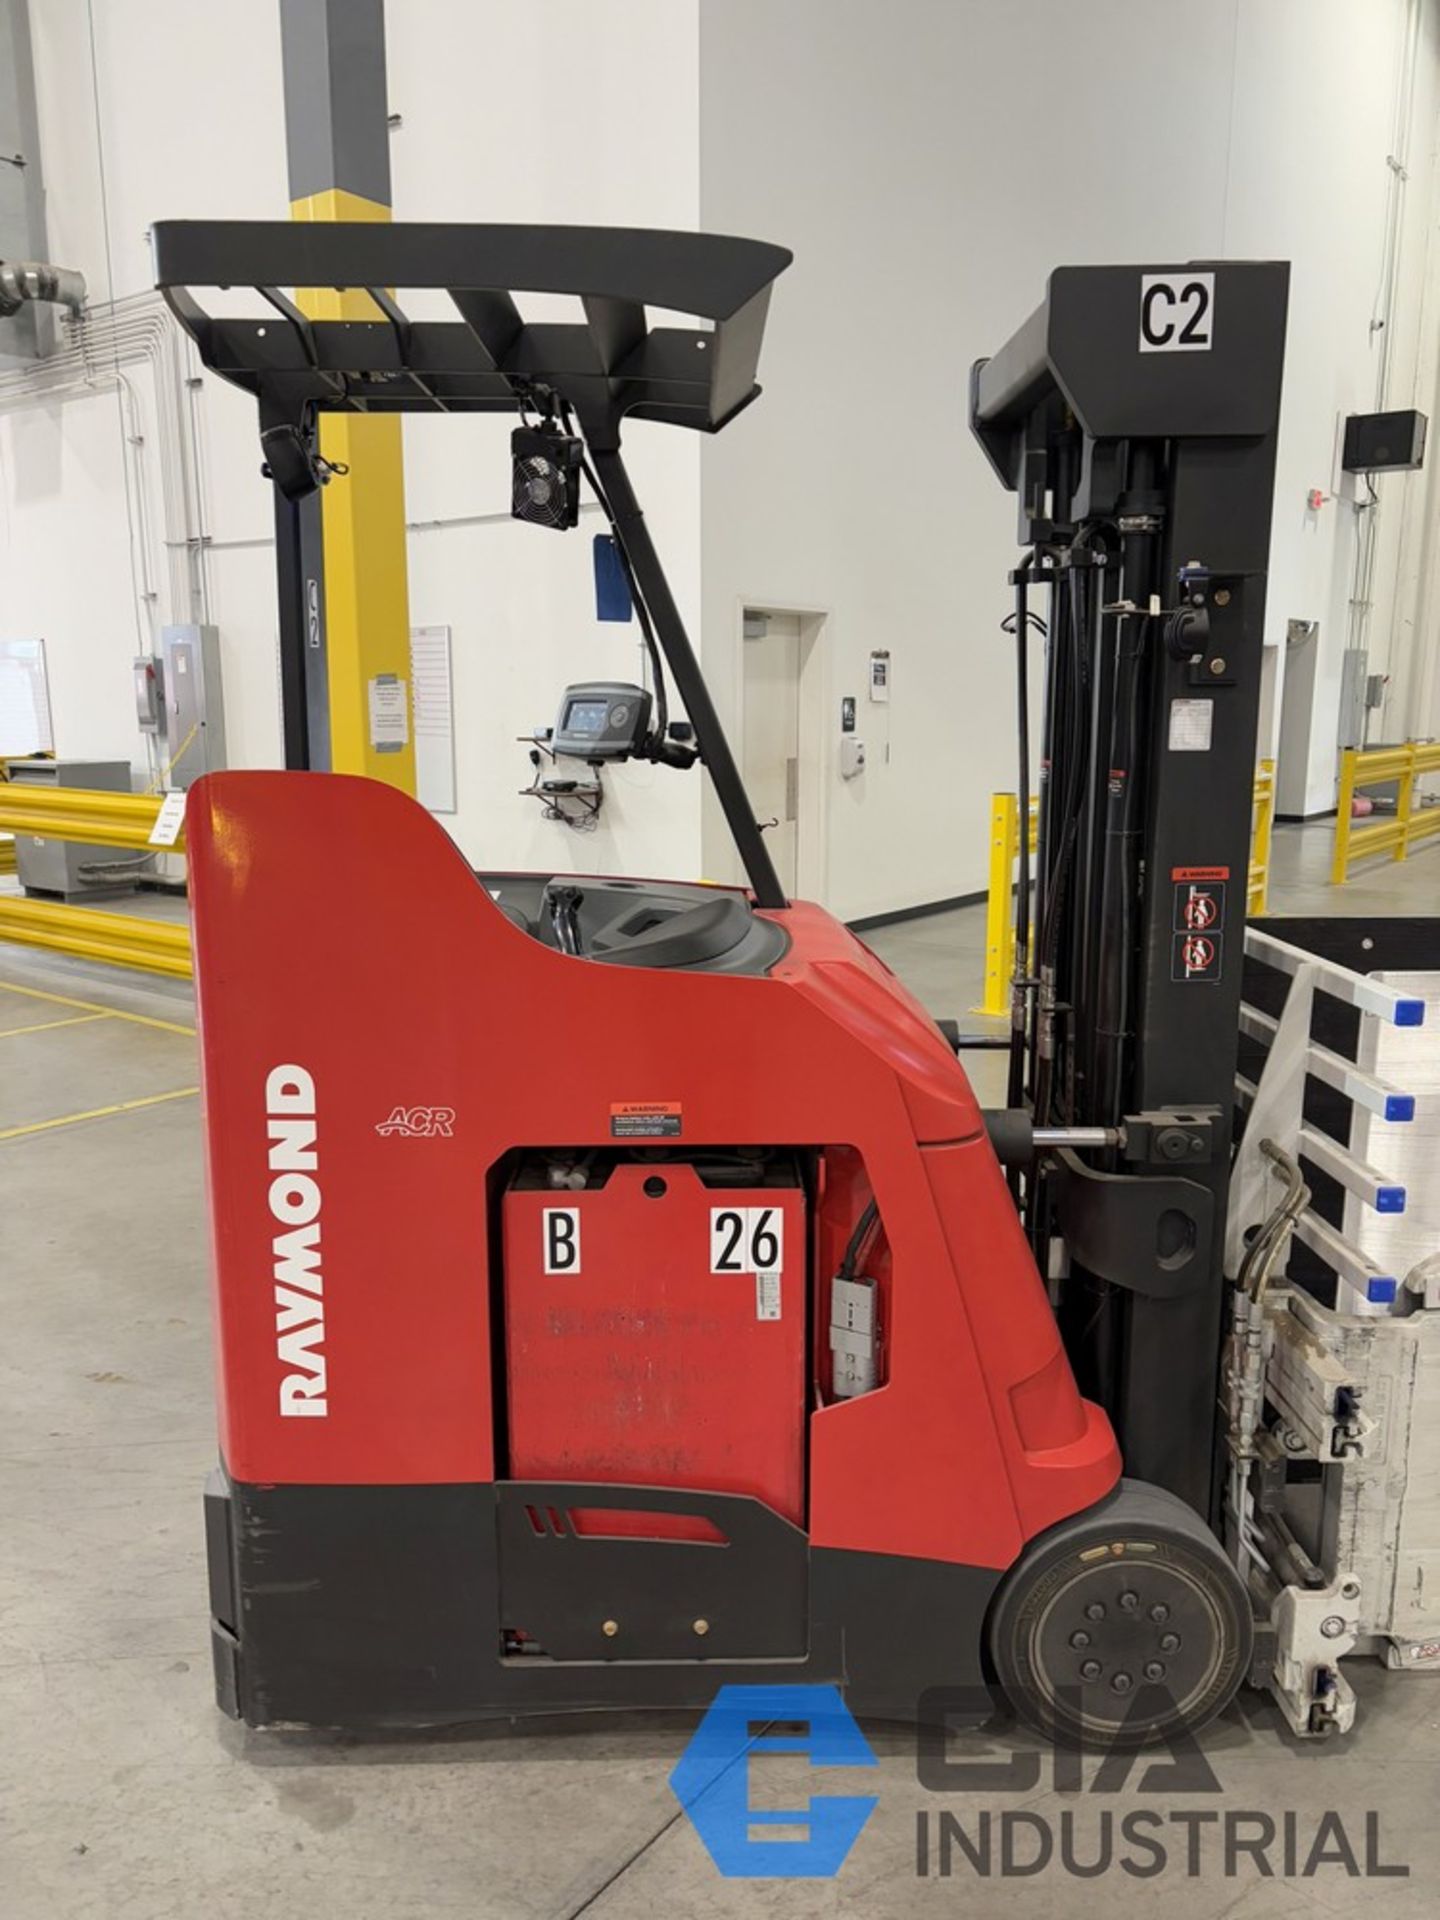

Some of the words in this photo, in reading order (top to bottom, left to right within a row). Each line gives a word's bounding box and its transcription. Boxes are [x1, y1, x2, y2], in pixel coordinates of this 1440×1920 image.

[1141, 282, 1209, 346] C2
[375, 1106, 456, 1137] ACR
[266, 1064, 329, 1417] RAYMOND
[549, 1212, 574, 1268] B
[715, 1209, 779, 1269] 26
